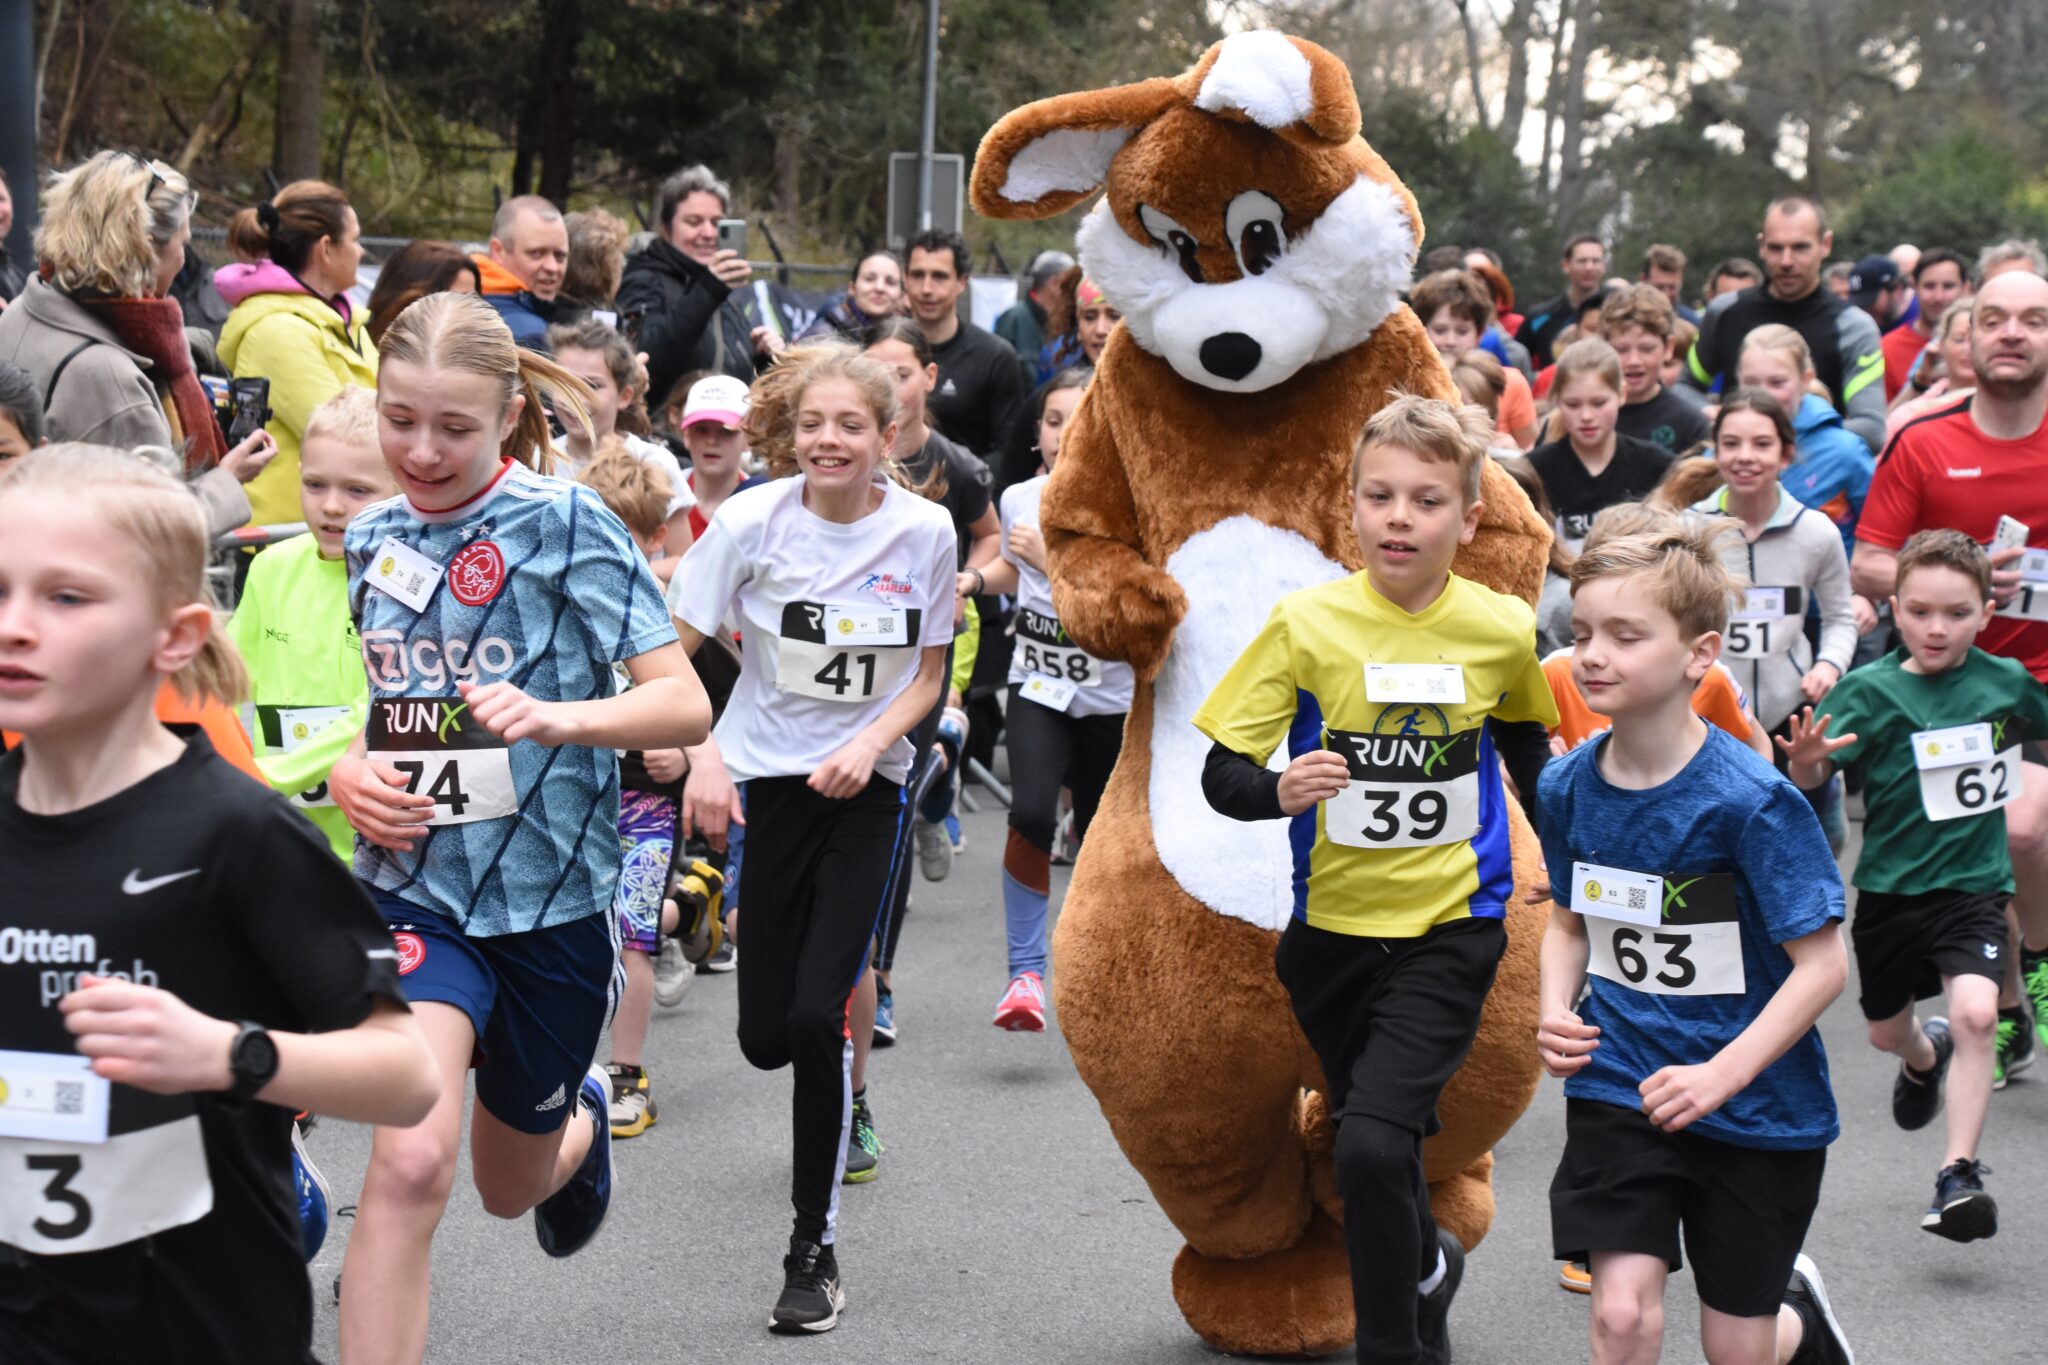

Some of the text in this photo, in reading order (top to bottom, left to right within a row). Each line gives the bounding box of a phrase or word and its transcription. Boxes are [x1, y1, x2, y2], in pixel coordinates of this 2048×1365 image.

[1728, 622, 1769, 653] 51
[814, 652, 876, 696] 41
[1024, 644, 1090, 683] 658
[384, 702, 468, 744] RUNX
[1349, 735, 1461, 777] RUNX
[394, 760, 470, 816] 74
[1956, 760, 2009, 809] 62
[1361, 790, 1448, 842] 39
[0, 926, 96, 964] Otten
[1612, 927, 1696, 988] 63
[25, 1154, 93, 1240] 3
